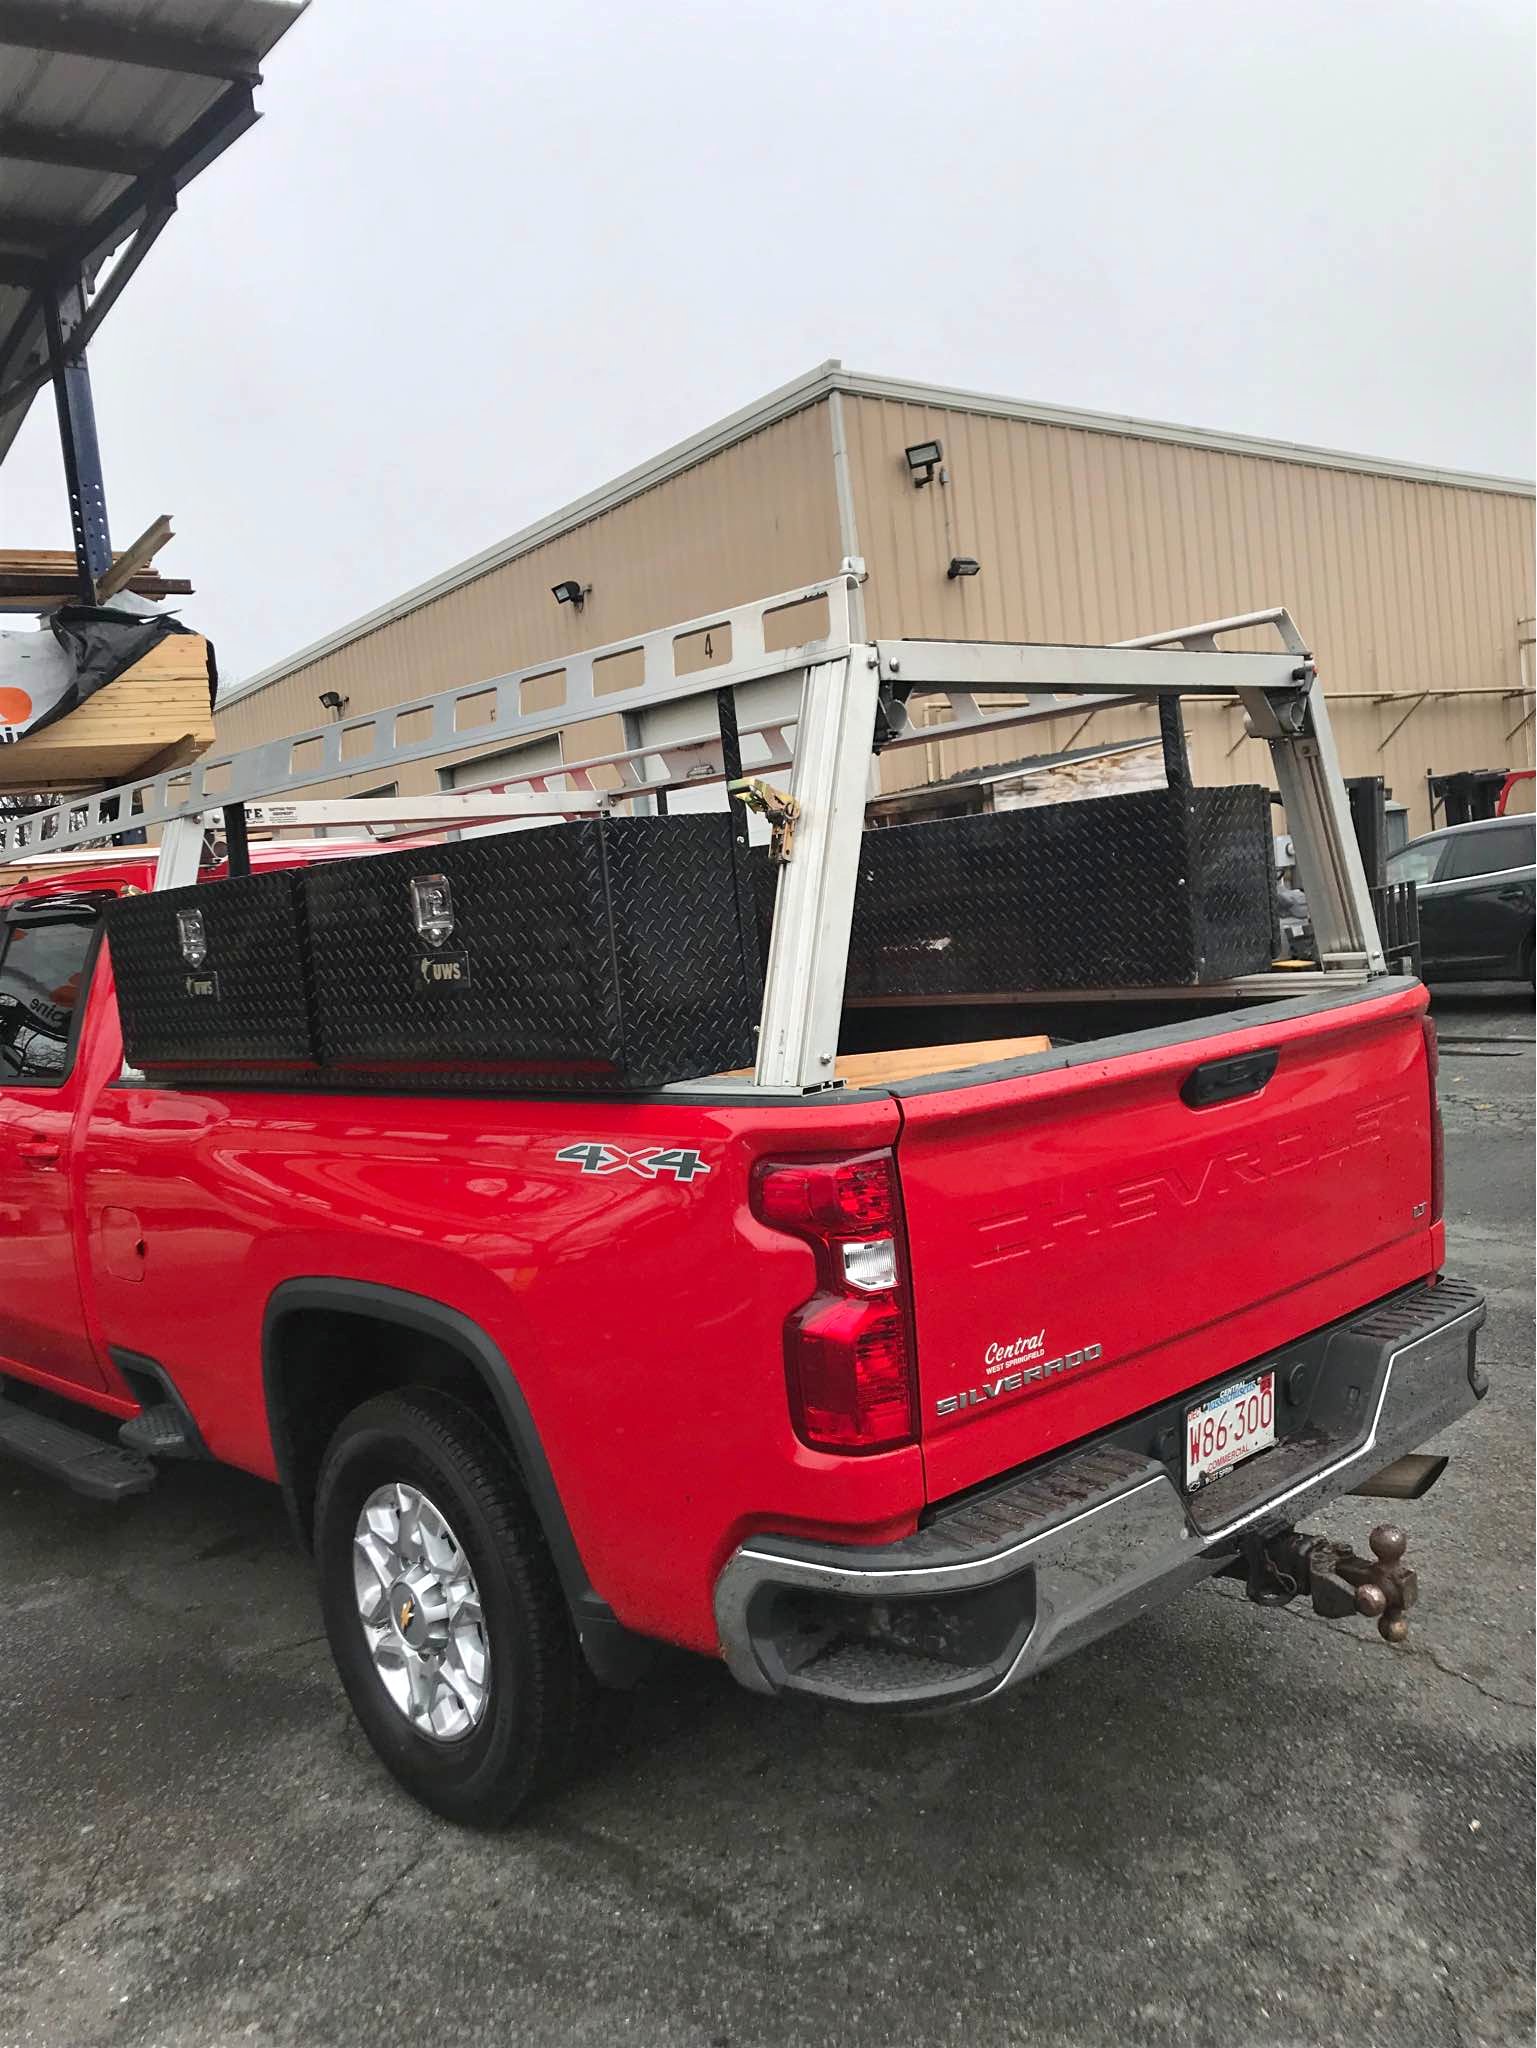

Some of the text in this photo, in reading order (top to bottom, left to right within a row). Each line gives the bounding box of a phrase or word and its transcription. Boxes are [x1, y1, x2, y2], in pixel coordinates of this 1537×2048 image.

[704, 633, 713, 660] 4
[432, 963, 461, 980] UWS
[984, 1328, 1046, 1365] Central
[985, 1348, 1045, 1376] WEST SPRINGFIELD
[936, 1343, 1102, 1416] SILVERADO
[1207, 1445, 1249, 1472] COMMERCIAL
